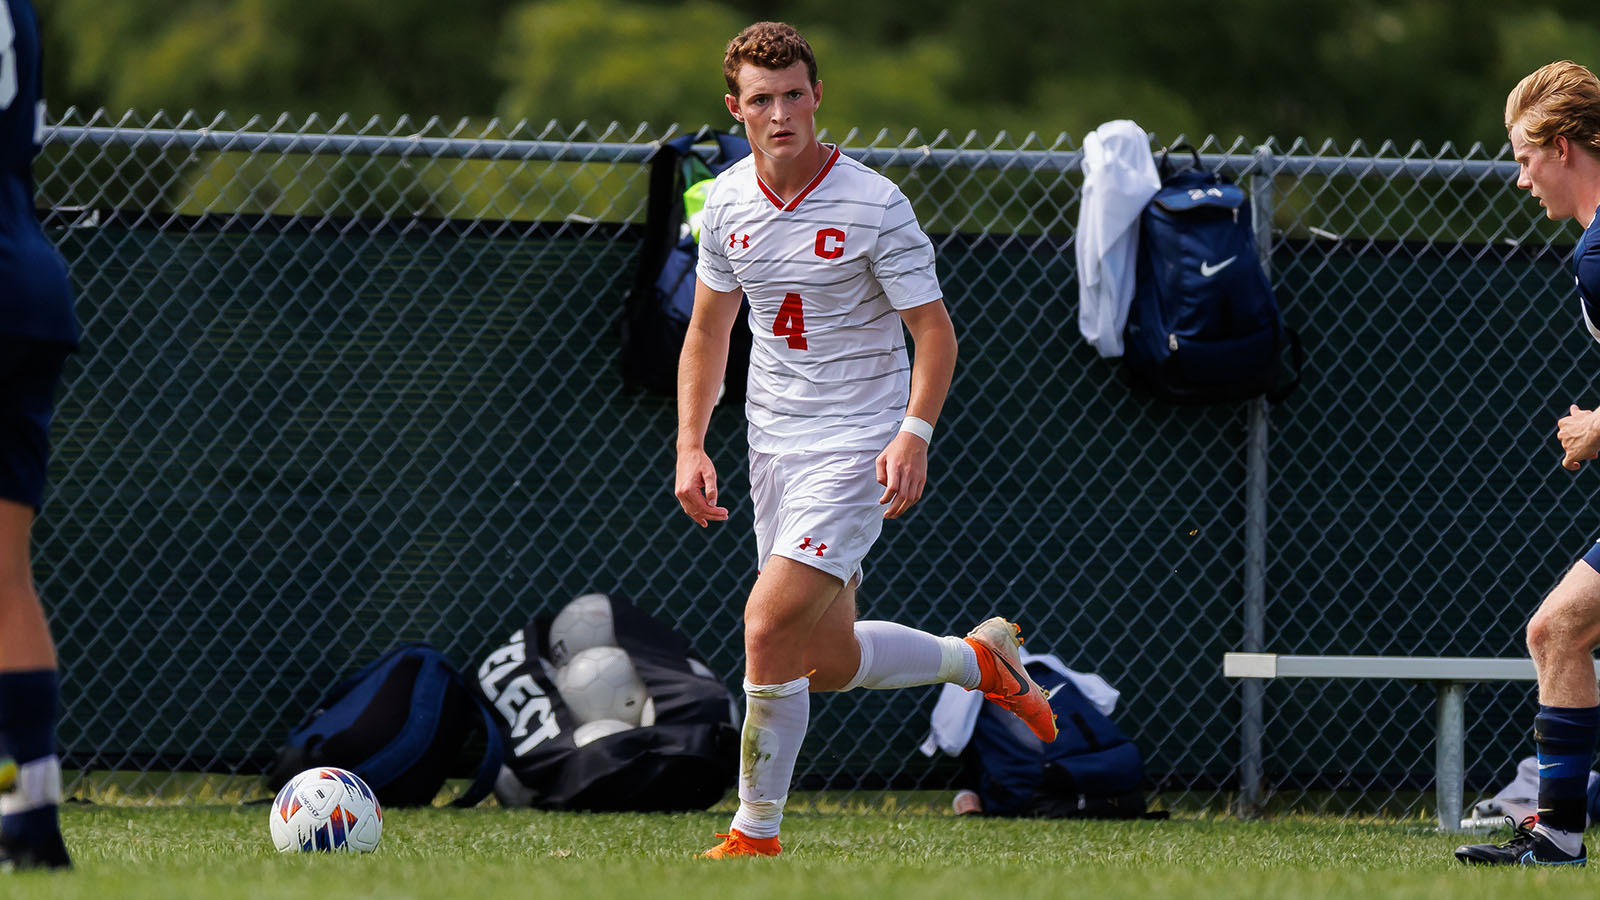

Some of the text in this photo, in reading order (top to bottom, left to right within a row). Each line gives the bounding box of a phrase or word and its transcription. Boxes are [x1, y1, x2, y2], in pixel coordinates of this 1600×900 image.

[814, 227, 846, 259] C
[772, 292, 809, 350] 4
[478, 629, 561, 757] ELECT
